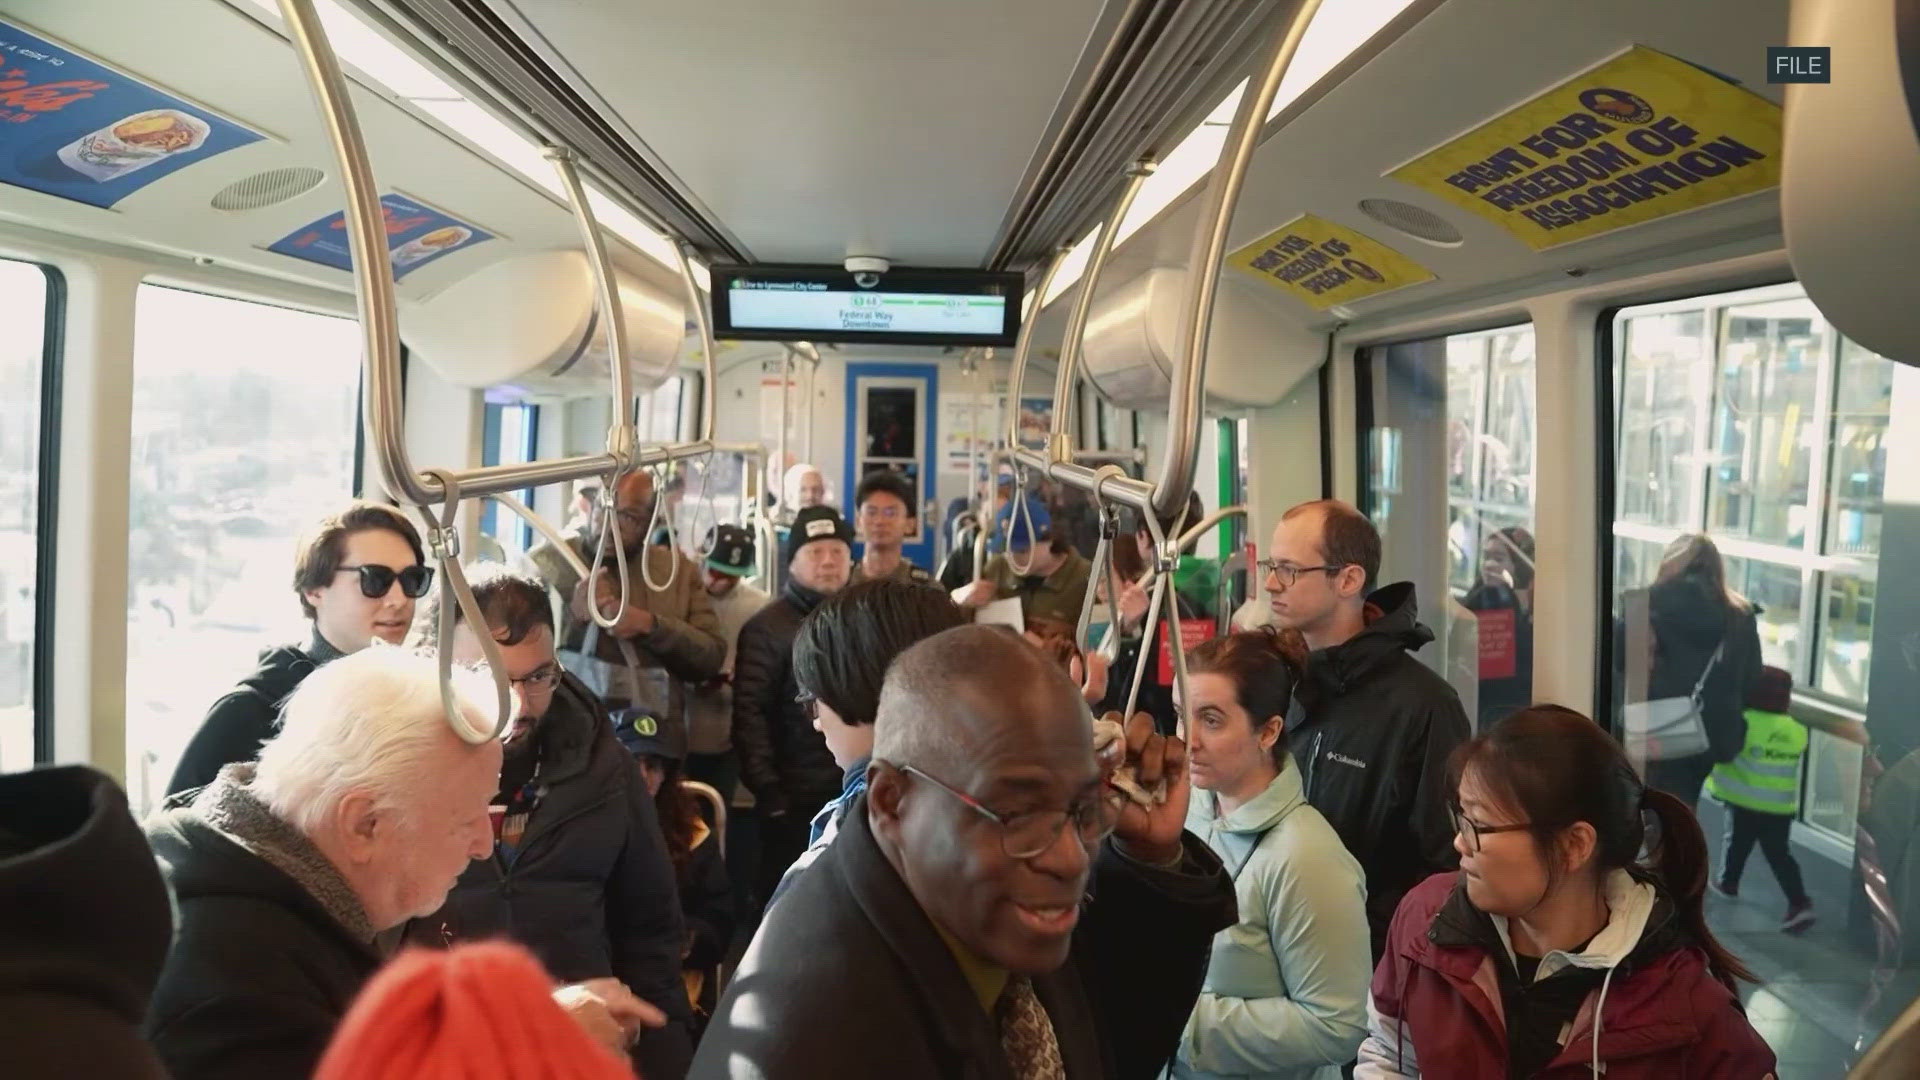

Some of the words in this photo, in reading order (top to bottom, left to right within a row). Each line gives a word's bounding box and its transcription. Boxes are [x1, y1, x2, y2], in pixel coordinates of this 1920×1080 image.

[1445, 147, 1539, 193] FIGHT
[1520, 112, 1617, 158] FOR
[1481, 141, 1641, 212] FREEDOM
[1625, 116, 1699, 157] OF
[1520, 135, 1767, 231] ASSOCIATION
[796, 281, 808, 291] City
[808, 282, 828, 291] Center
[840, 310, 873, 320] Federal
[875, 310, 893, 321] Way
[842, 319, 890, 329] Downtown
[1333, 753, 1366, 769] Columbia
